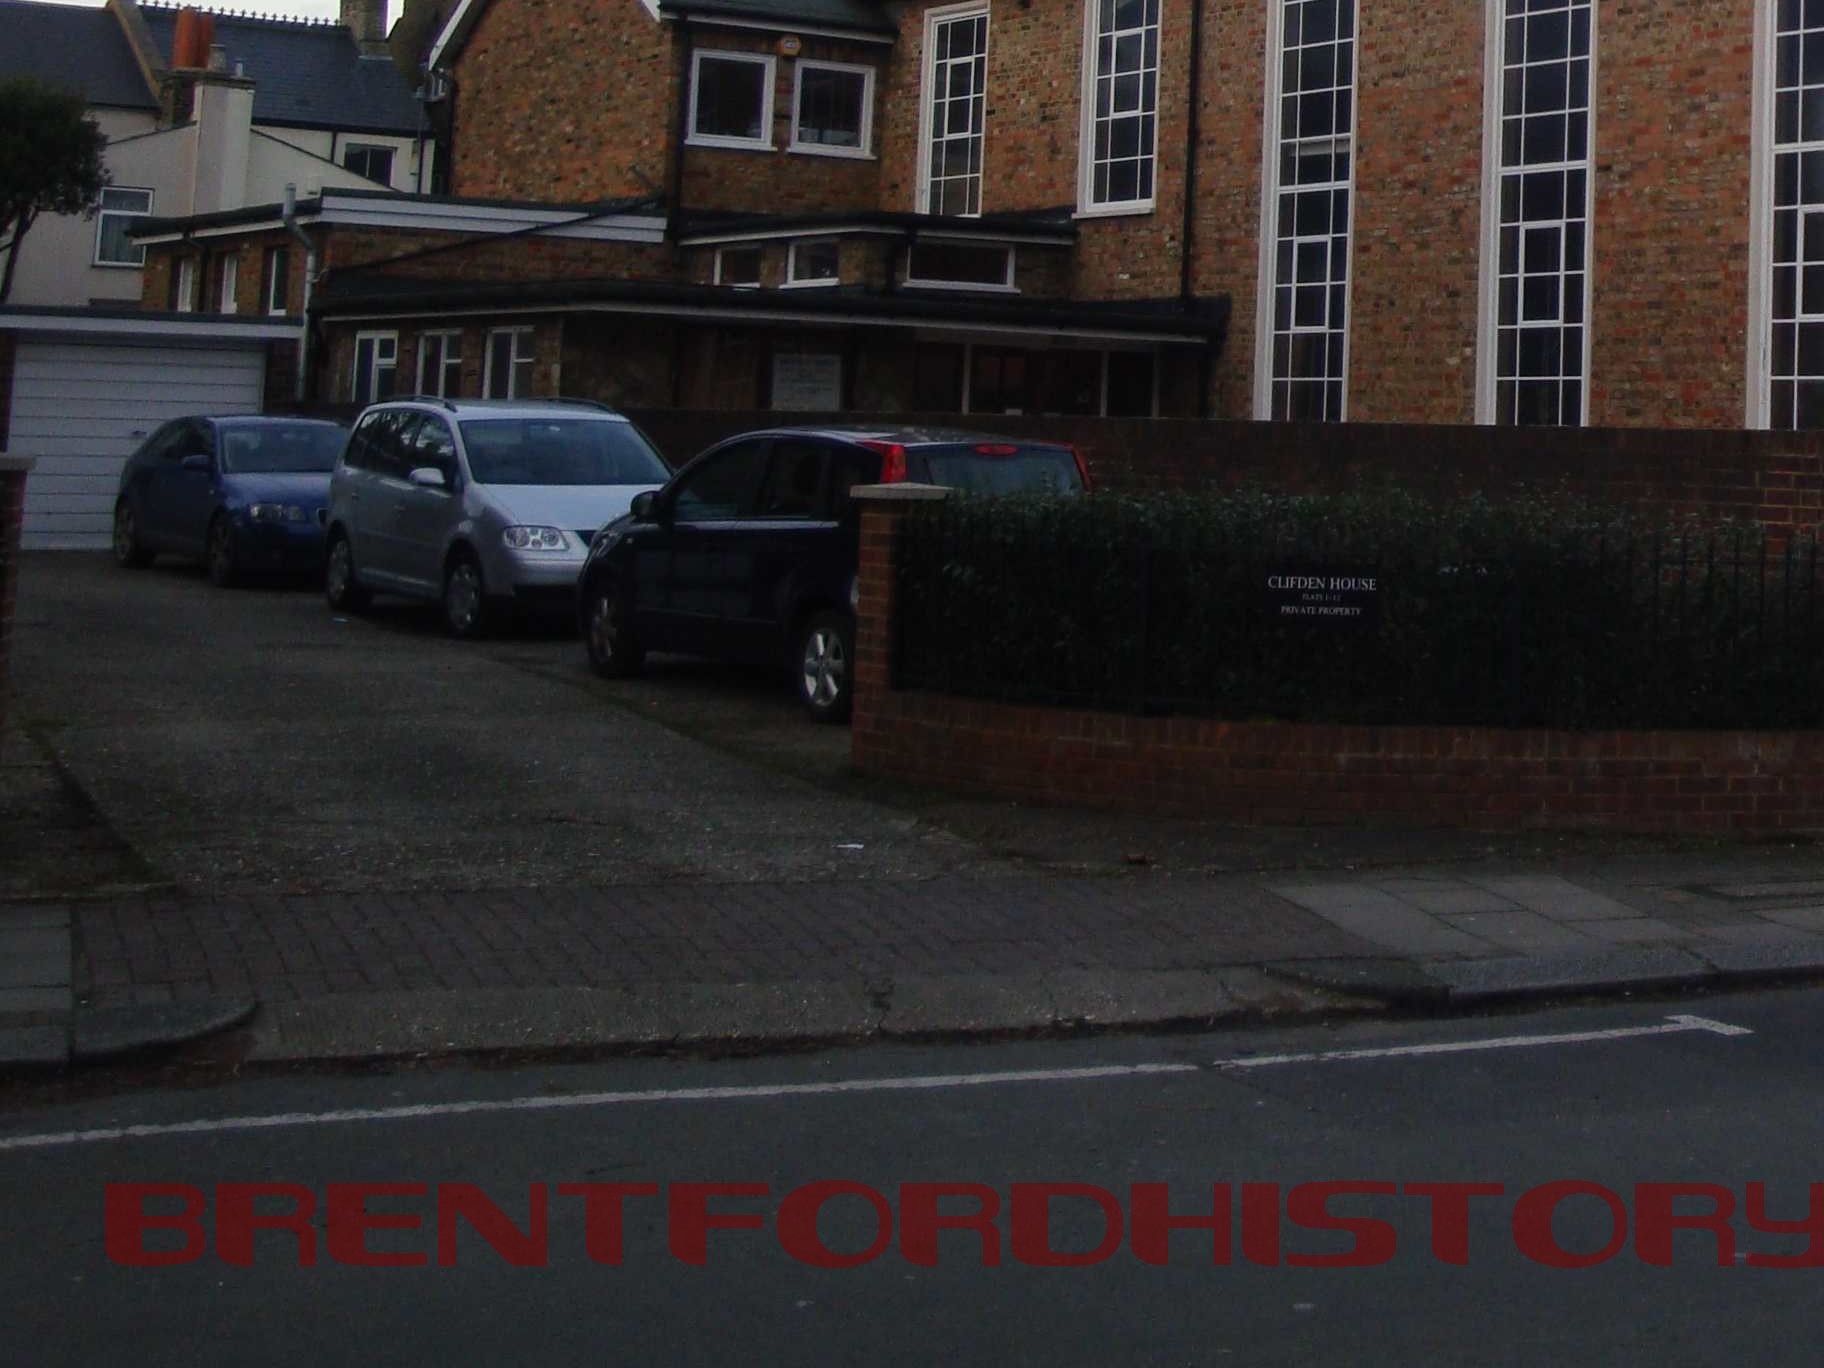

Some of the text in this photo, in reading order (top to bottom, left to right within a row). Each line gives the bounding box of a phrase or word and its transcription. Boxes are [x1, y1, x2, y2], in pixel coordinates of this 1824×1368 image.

[1267, 575, 1377, 591] CLIFDEN HOUSE
[1280, 606, 1361, 617] PRIVATE PROPERTY
